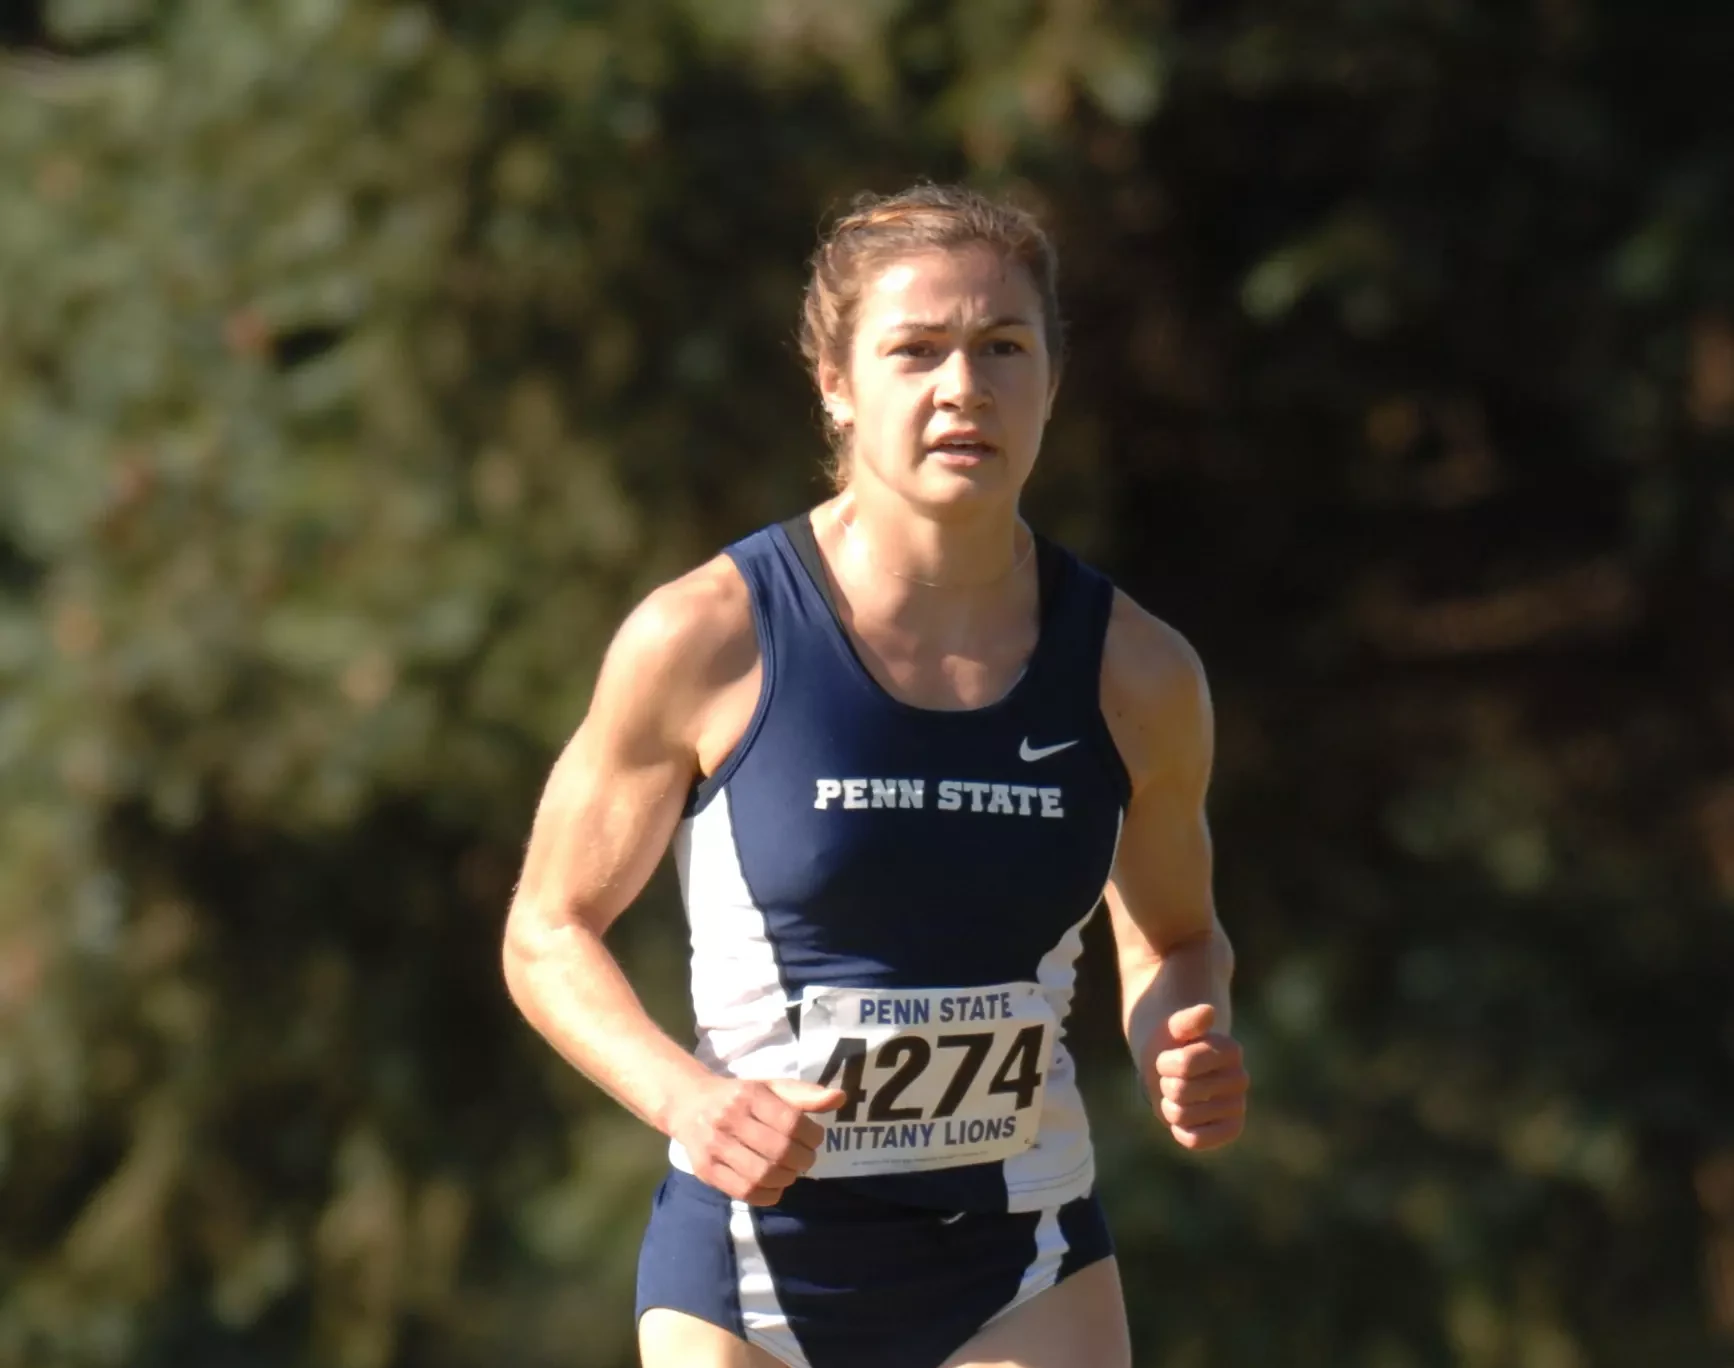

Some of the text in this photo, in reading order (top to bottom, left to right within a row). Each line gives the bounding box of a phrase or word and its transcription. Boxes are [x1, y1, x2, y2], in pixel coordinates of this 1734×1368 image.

[814, 779, 1065, 818] PENN STATE
[860, 992, 1013, 1024] PENN STATE
[816, 1024, 1045, 1123] 4274
[826, 1116, 1016, 1153] NITTANY LIONS
